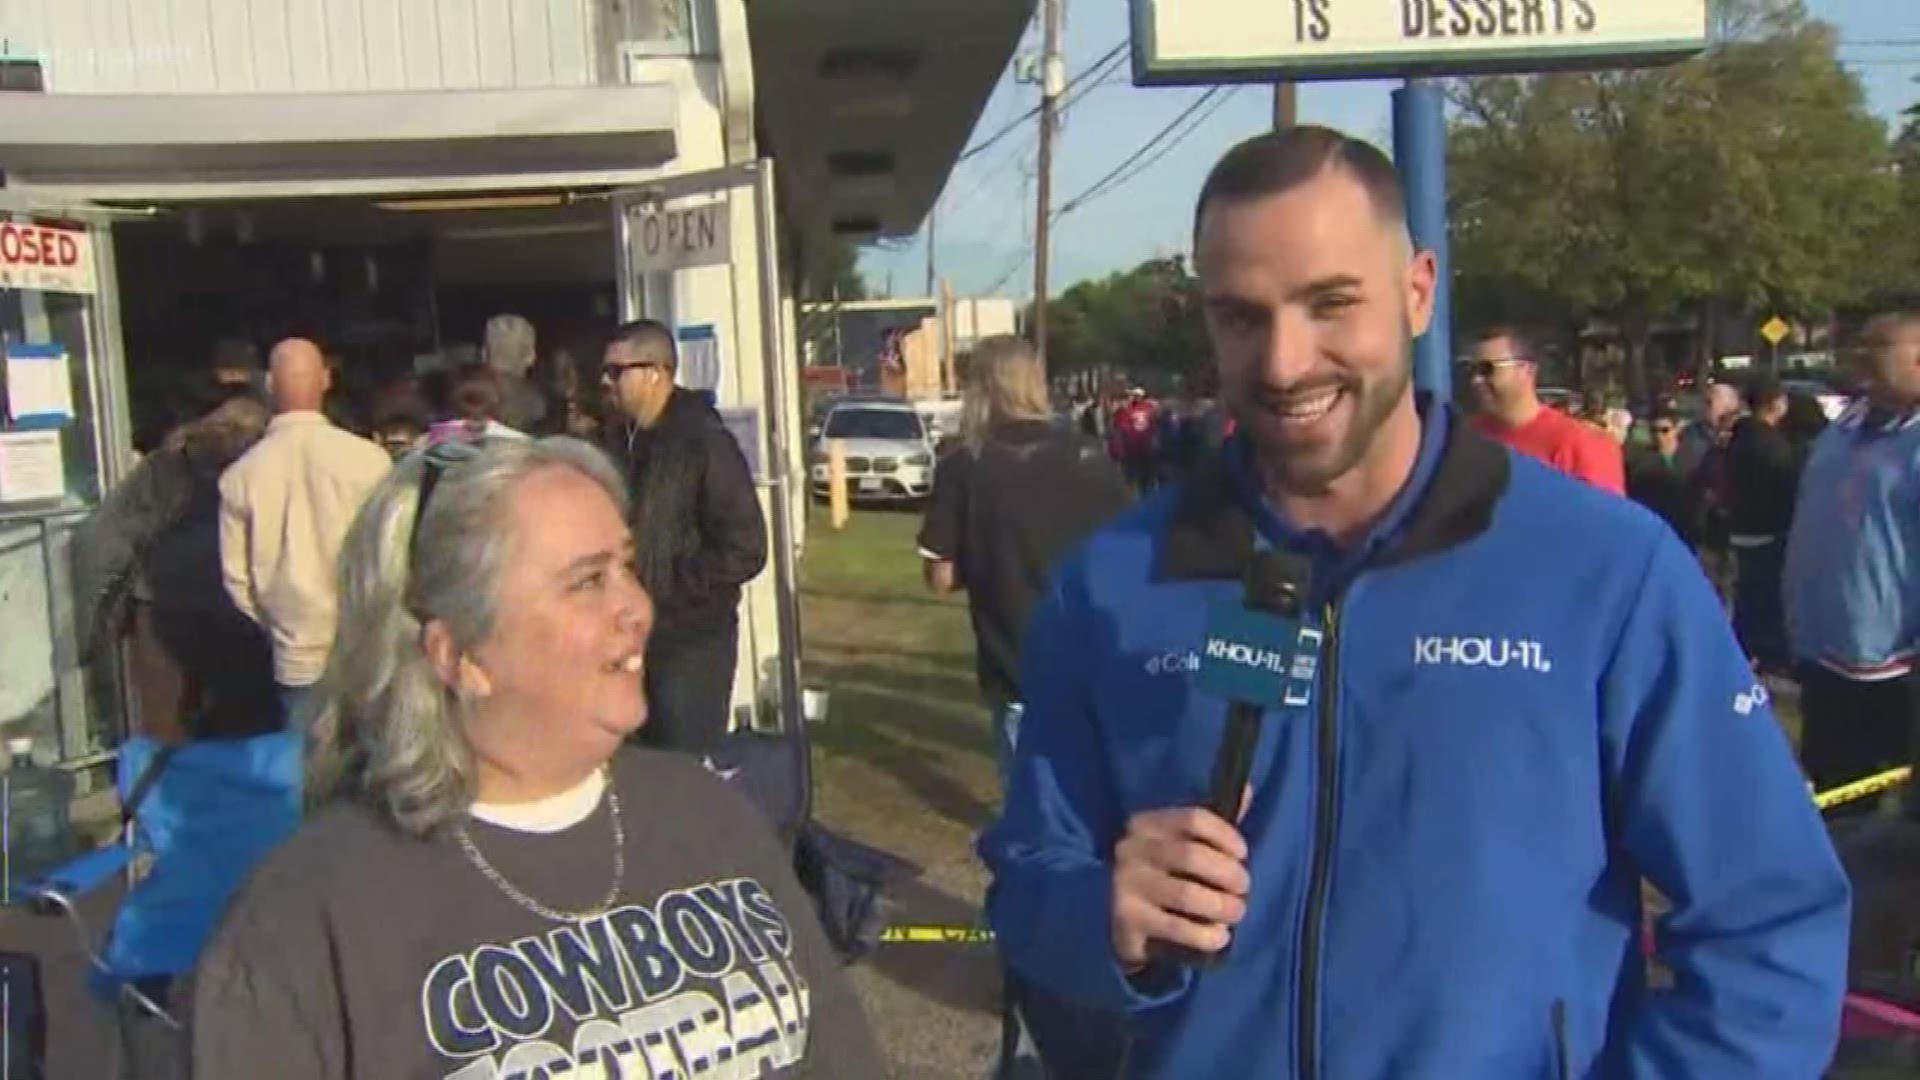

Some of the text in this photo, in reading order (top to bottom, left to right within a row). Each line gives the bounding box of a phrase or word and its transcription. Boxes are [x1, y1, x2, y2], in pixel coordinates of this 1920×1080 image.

[1295, 0, 1597, 42] IS DESSERTS
[643, 209, 715, 256] OPEN
[422, 877, 792, 1057] COWBOYS
